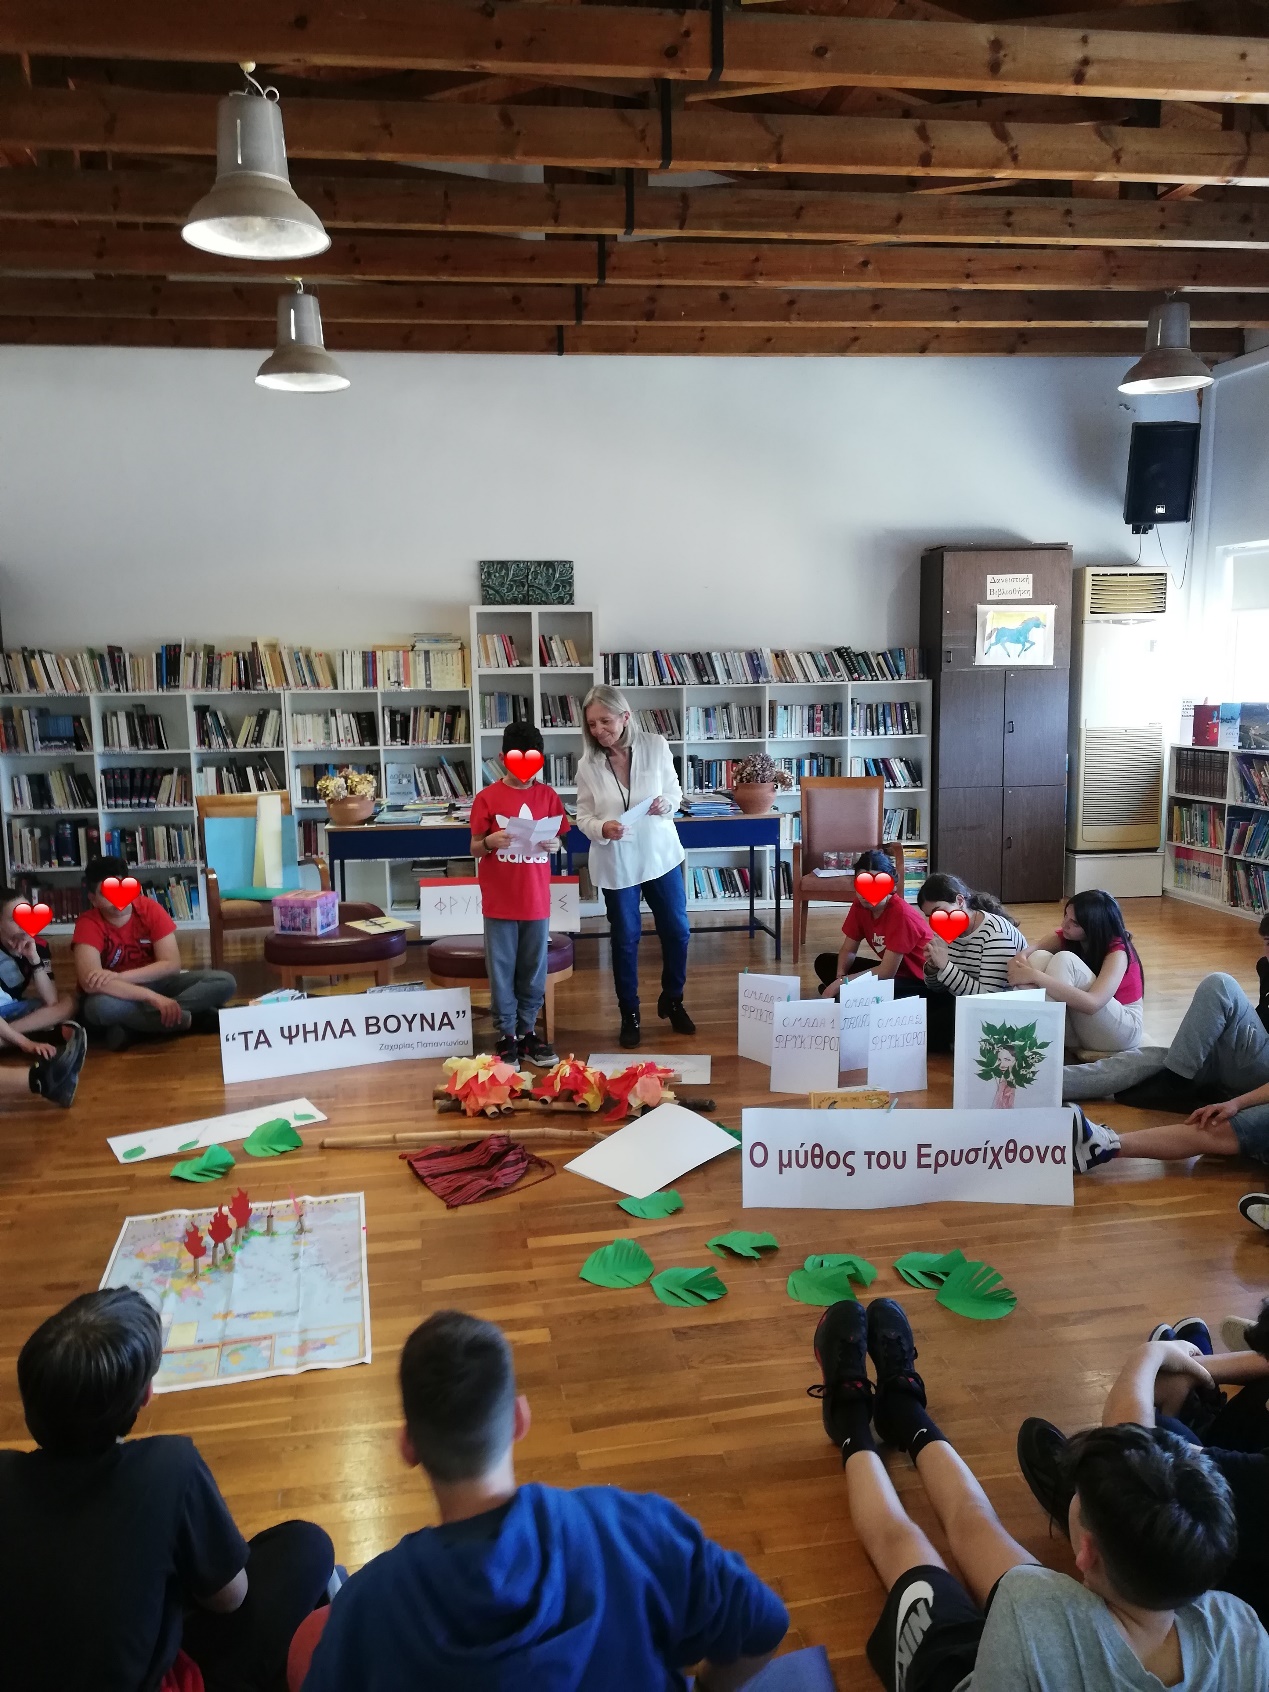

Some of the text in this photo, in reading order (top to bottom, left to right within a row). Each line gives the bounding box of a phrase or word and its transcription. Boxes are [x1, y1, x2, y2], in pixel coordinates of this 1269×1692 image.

[990, 575, 1030, 584] Δανειστική
[989, 588, 1031, 597] Βιβλιοθήκη
[782, 1017, 836, 1029] ΟΜΑΔΑ 1
[877, 1015, 914, 1029] ΟΜΑΔΑ
[279, 1018, 357, 1046] ΨΗΛΑ
[378, 1039, 469, 1051] Ζαχαρίας Παπαντωνίου
[749, 1138, 1067, 1177] Ο μύθος του Ερυσίχθονα
